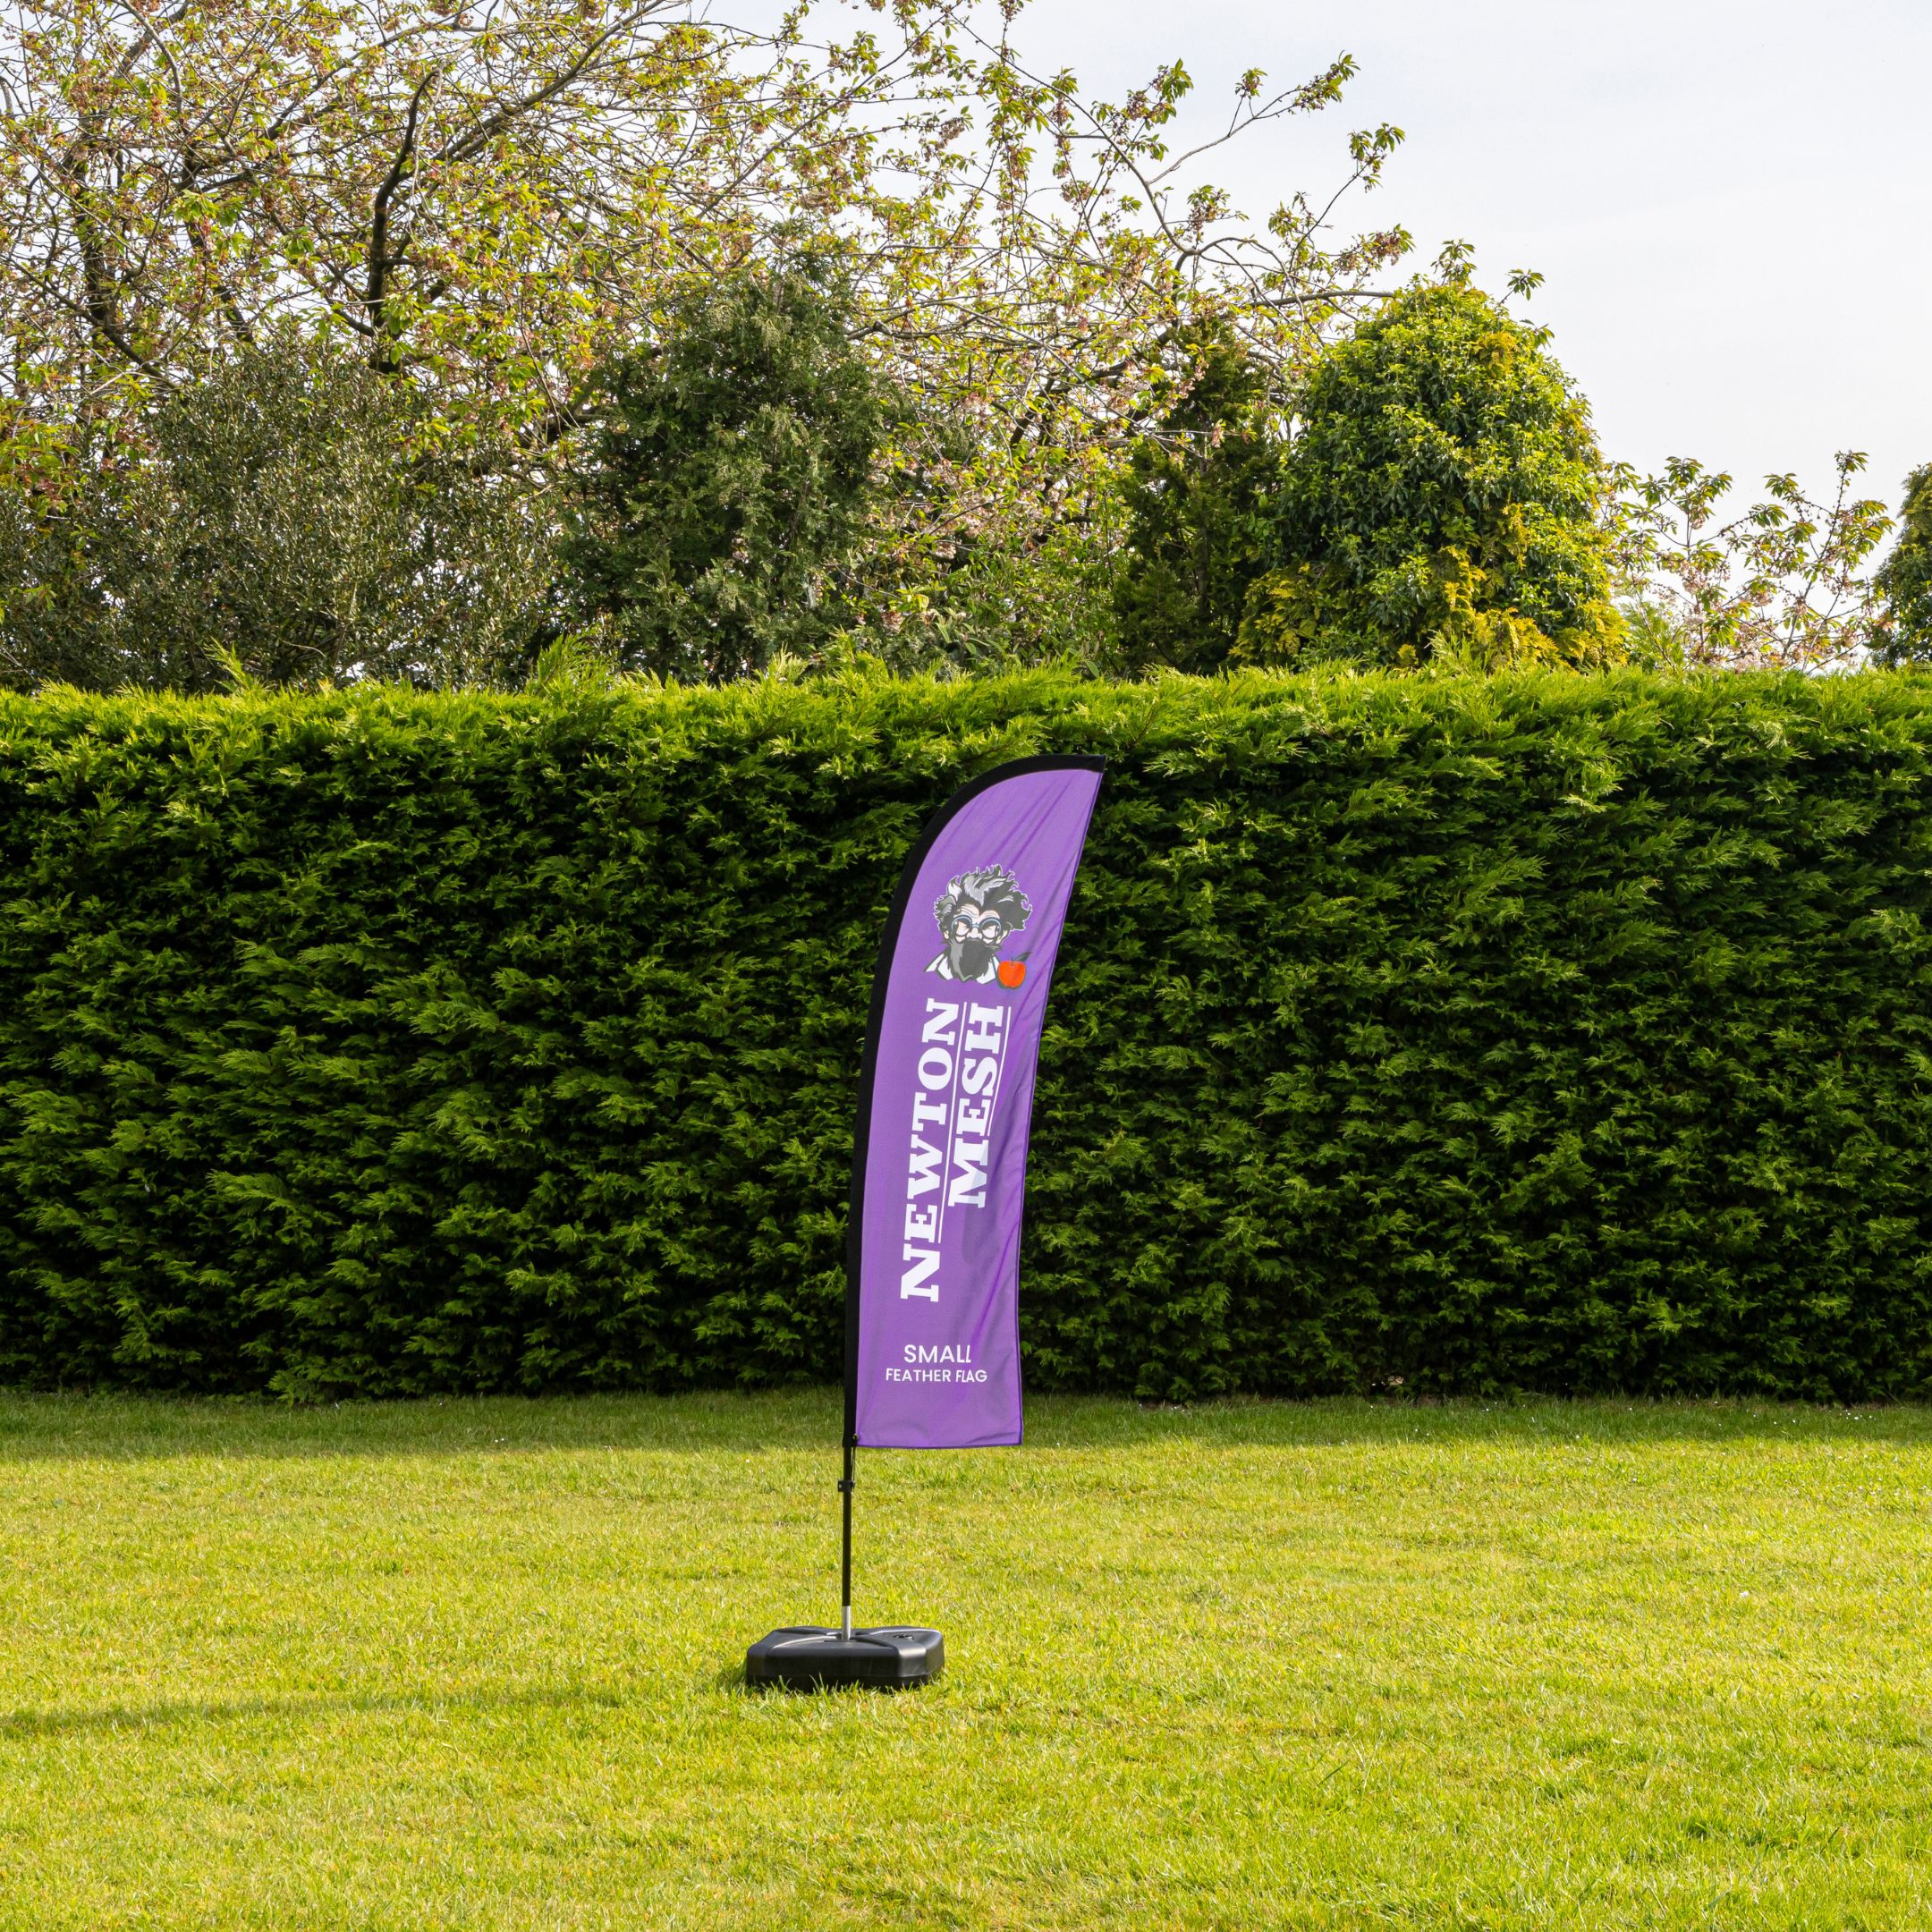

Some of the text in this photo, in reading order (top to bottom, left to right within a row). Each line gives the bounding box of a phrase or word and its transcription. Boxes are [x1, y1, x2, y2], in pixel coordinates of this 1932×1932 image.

[900, 997, 960, 1303] NEWTON
[947, 1001, 1004, 1209] MESH
[886, 1368, 987, 1384] FEATHER FLAG
[903, 1343, 971, 1364] SMALL
